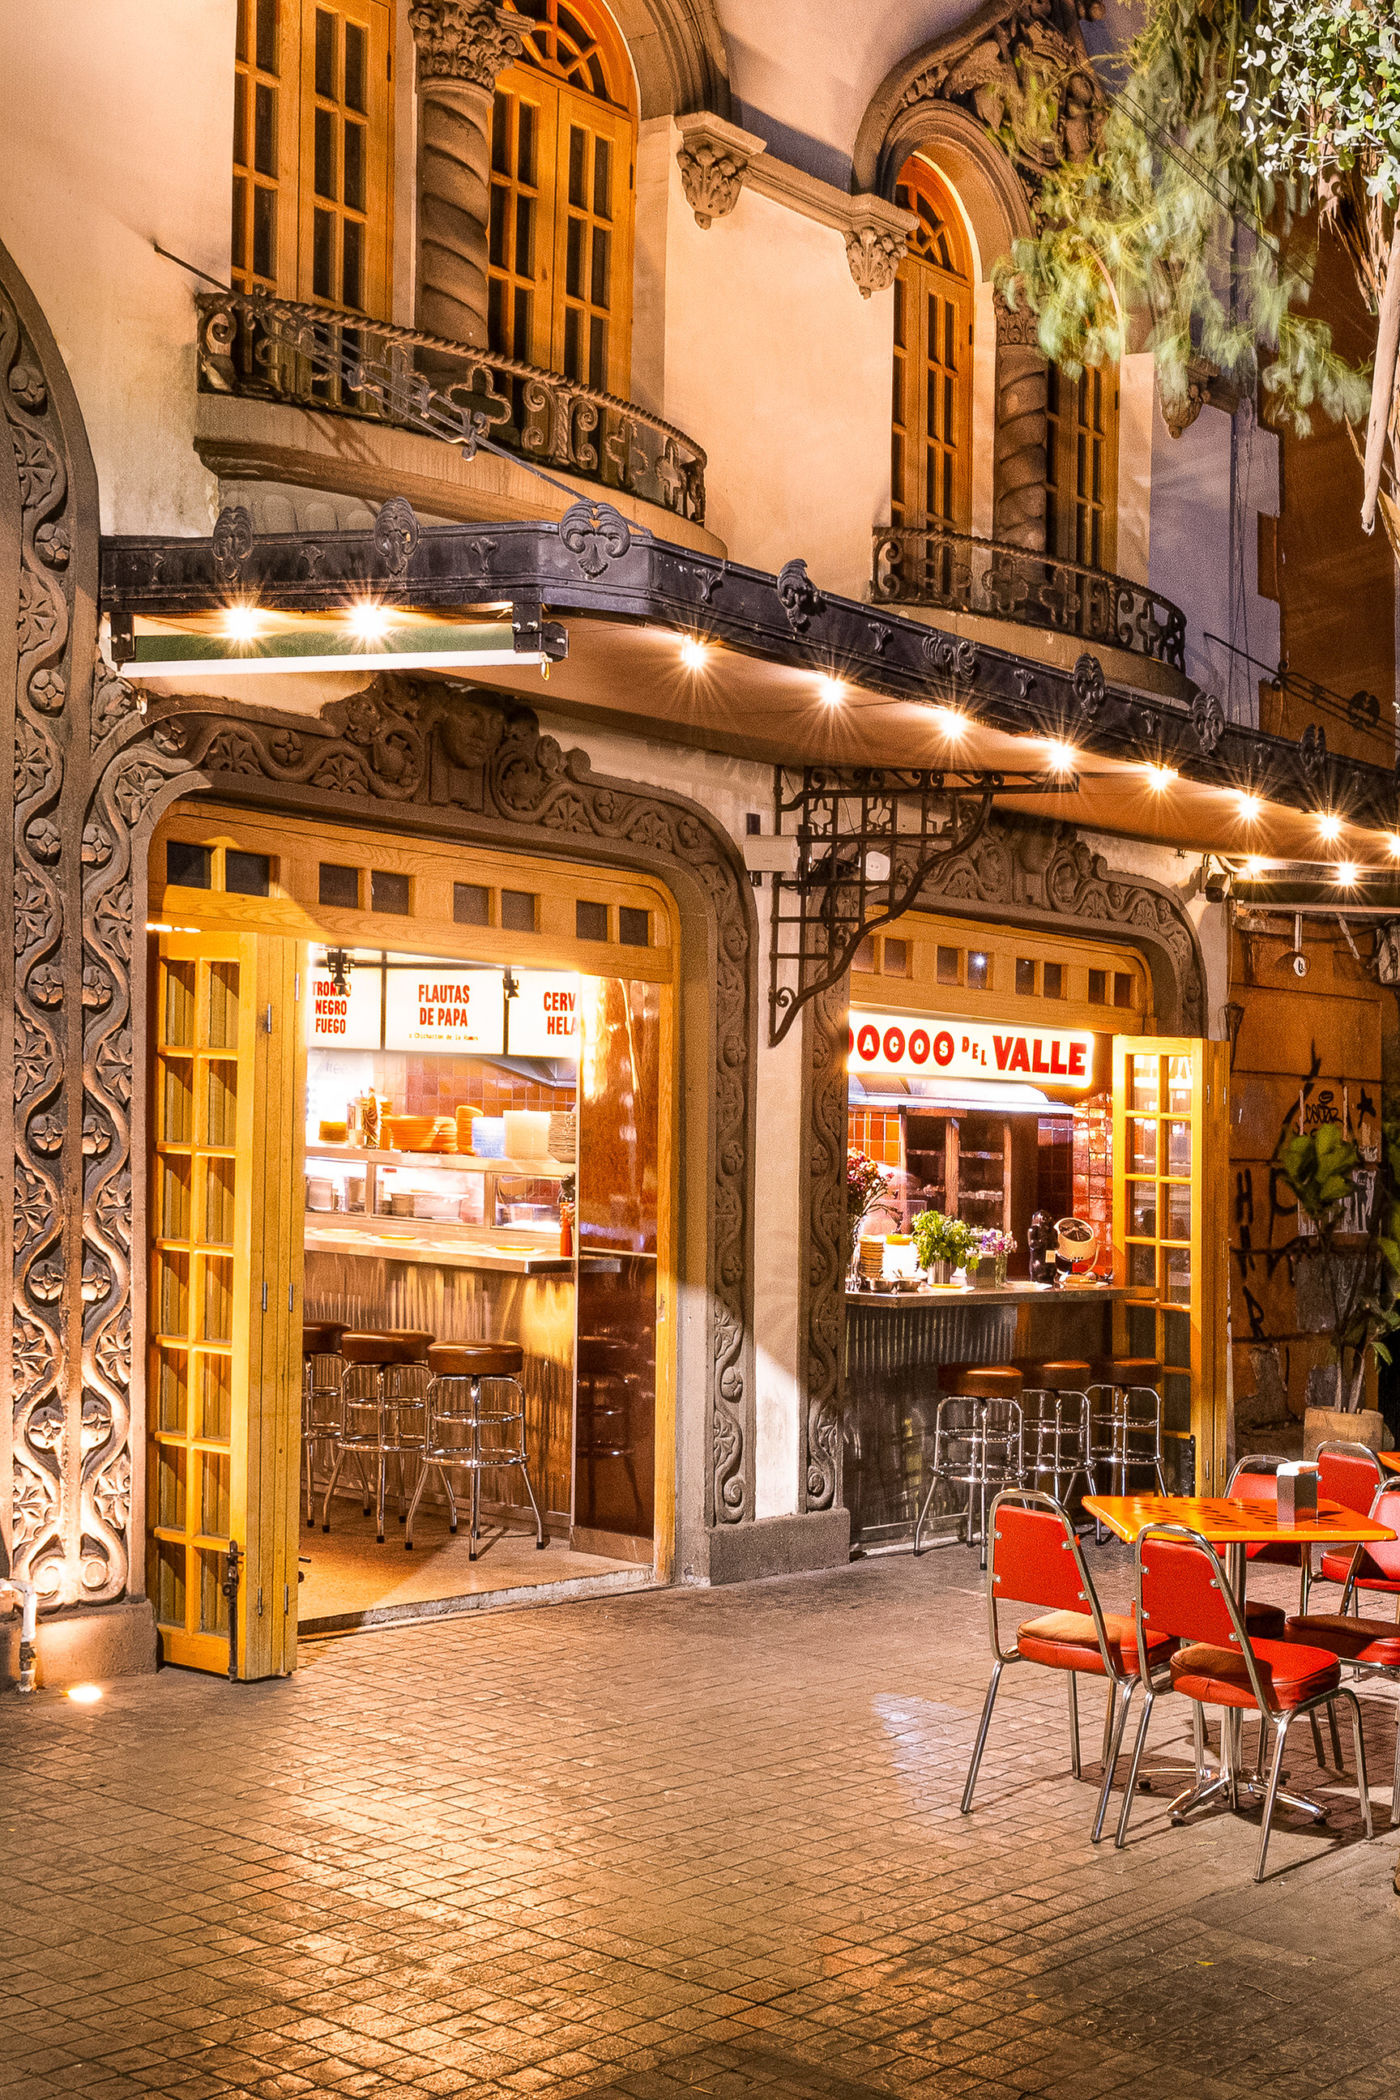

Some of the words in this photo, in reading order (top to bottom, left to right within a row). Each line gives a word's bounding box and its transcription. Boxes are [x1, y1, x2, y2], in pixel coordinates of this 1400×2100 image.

[418, 984, 471, 1004] FLAUTAS
[543, 991, 576, 1012] CERV
[315, 999, 347, 1016] NEGRO
[419, 1007, 434, 1025] DE
[437, 1008, 468, 1027] PAPA
[315, 1018, 346, 1034] FUEGO
[849, 1024, 955, 1067] ACOS
[962, 1036, 987, 1066] DEL
[992, 1035, 1087, 1076] VALLE
